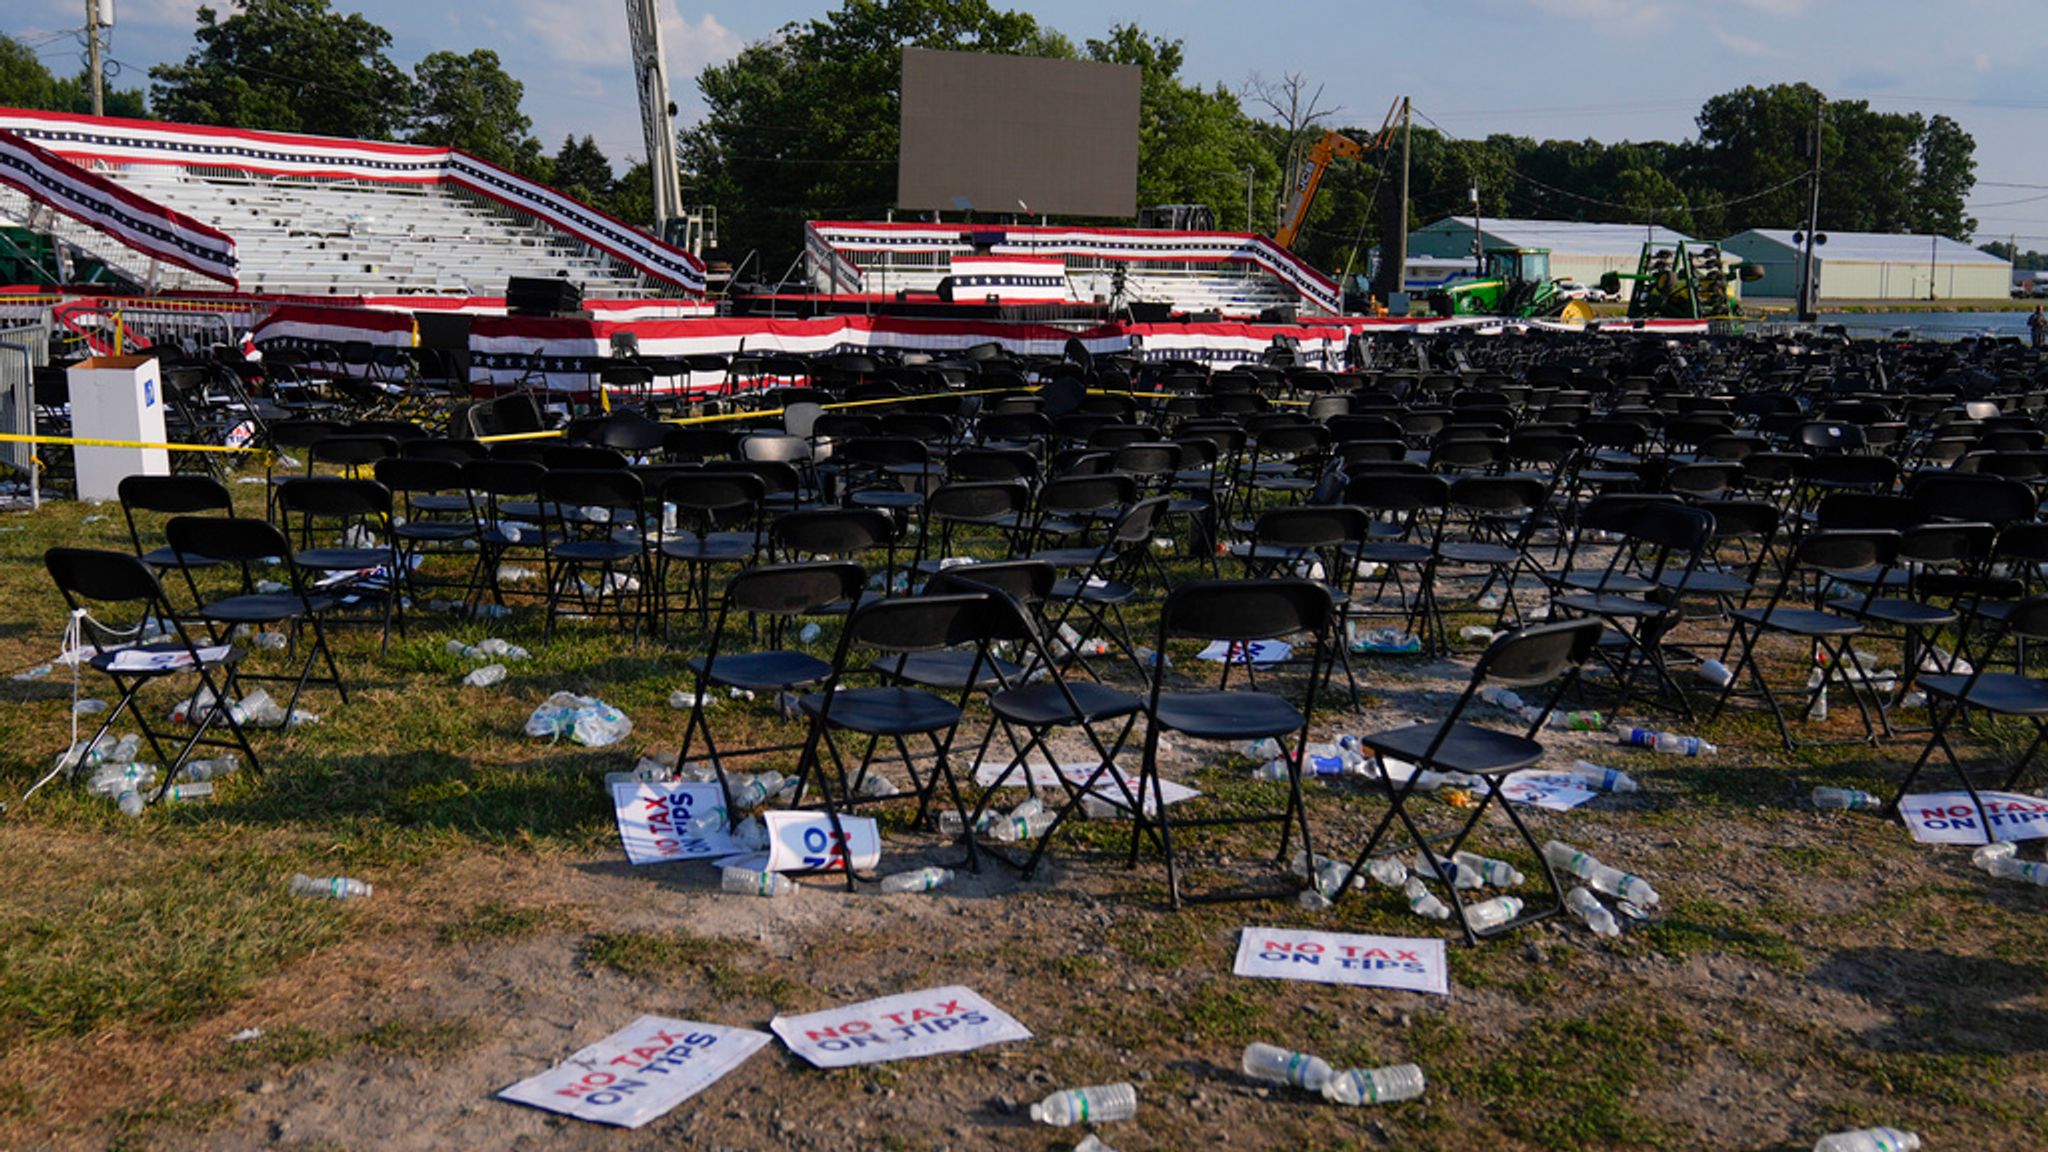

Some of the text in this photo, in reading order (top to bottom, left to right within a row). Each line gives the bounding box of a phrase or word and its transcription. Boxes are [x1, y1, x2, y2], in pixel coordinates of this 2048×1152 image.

[643, 795, 674, 834] TAX
[669, 792, 694, 837] TIPS
[1920, 802, 2048, 819] NO TAX
[1923, 818, 1977, 830] ON
[1259, 951, 1427, 974] ON TIPS
[1264, 940, 1420, 962] NO TAX
[804, 1000, 968, 1042] NO TAX
[816, 1032, 887, 1052] ON
[890, 1010, 990, 1041] TIPS
[554, 1029, 686, 1098] NO TAX
[586, 1077, 648, 1106] ON
[637, 1032, 719, 1075] TIPS
